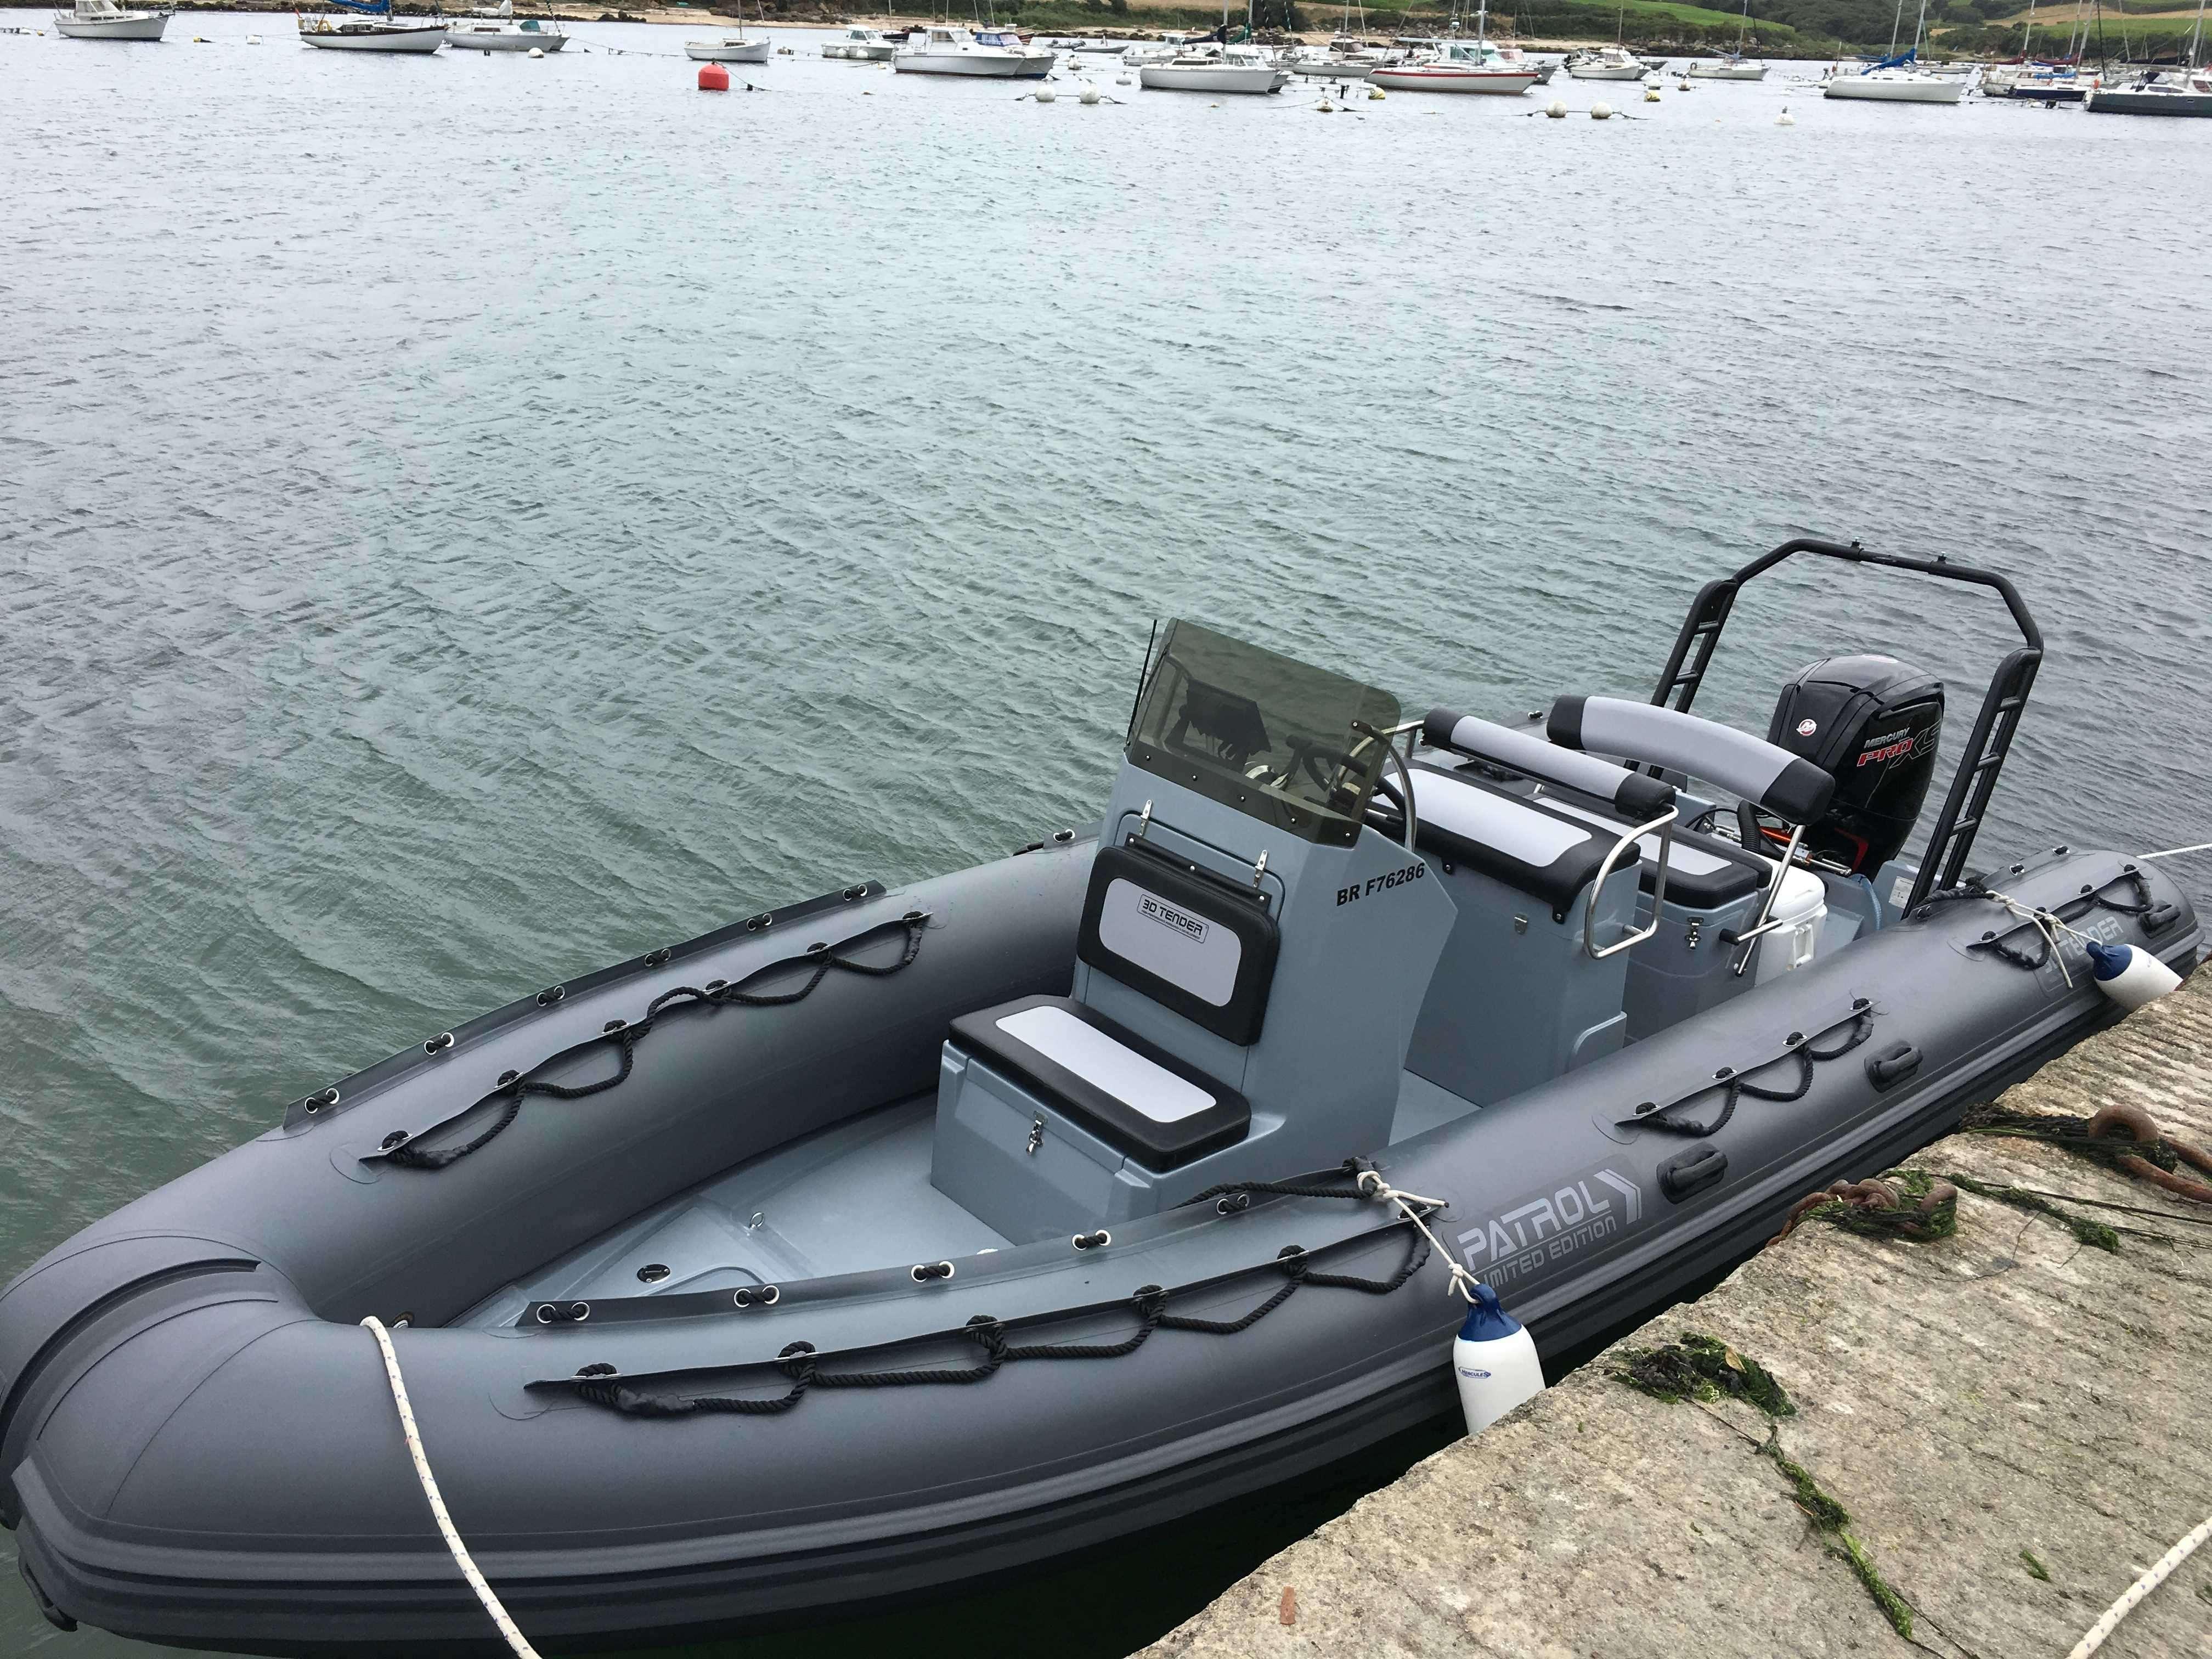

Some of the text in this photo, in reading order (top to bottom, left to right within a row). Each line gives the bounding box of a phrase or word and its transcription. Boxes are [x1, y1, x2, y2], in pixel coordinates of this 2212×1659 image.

[1857, 738, 1914, 767] PRO
[1864, 727, 1910, 748] MERCURY
[1336, 862, 1425, 906] BR F76286
[1142, 899, 1158, 913] 3D
[1159, 906, 1203, 936] TENDER
[1457, 1180, 1610, 1272] PATROL
[1483, 1215, 1617, 1289] IMITED EDITION
